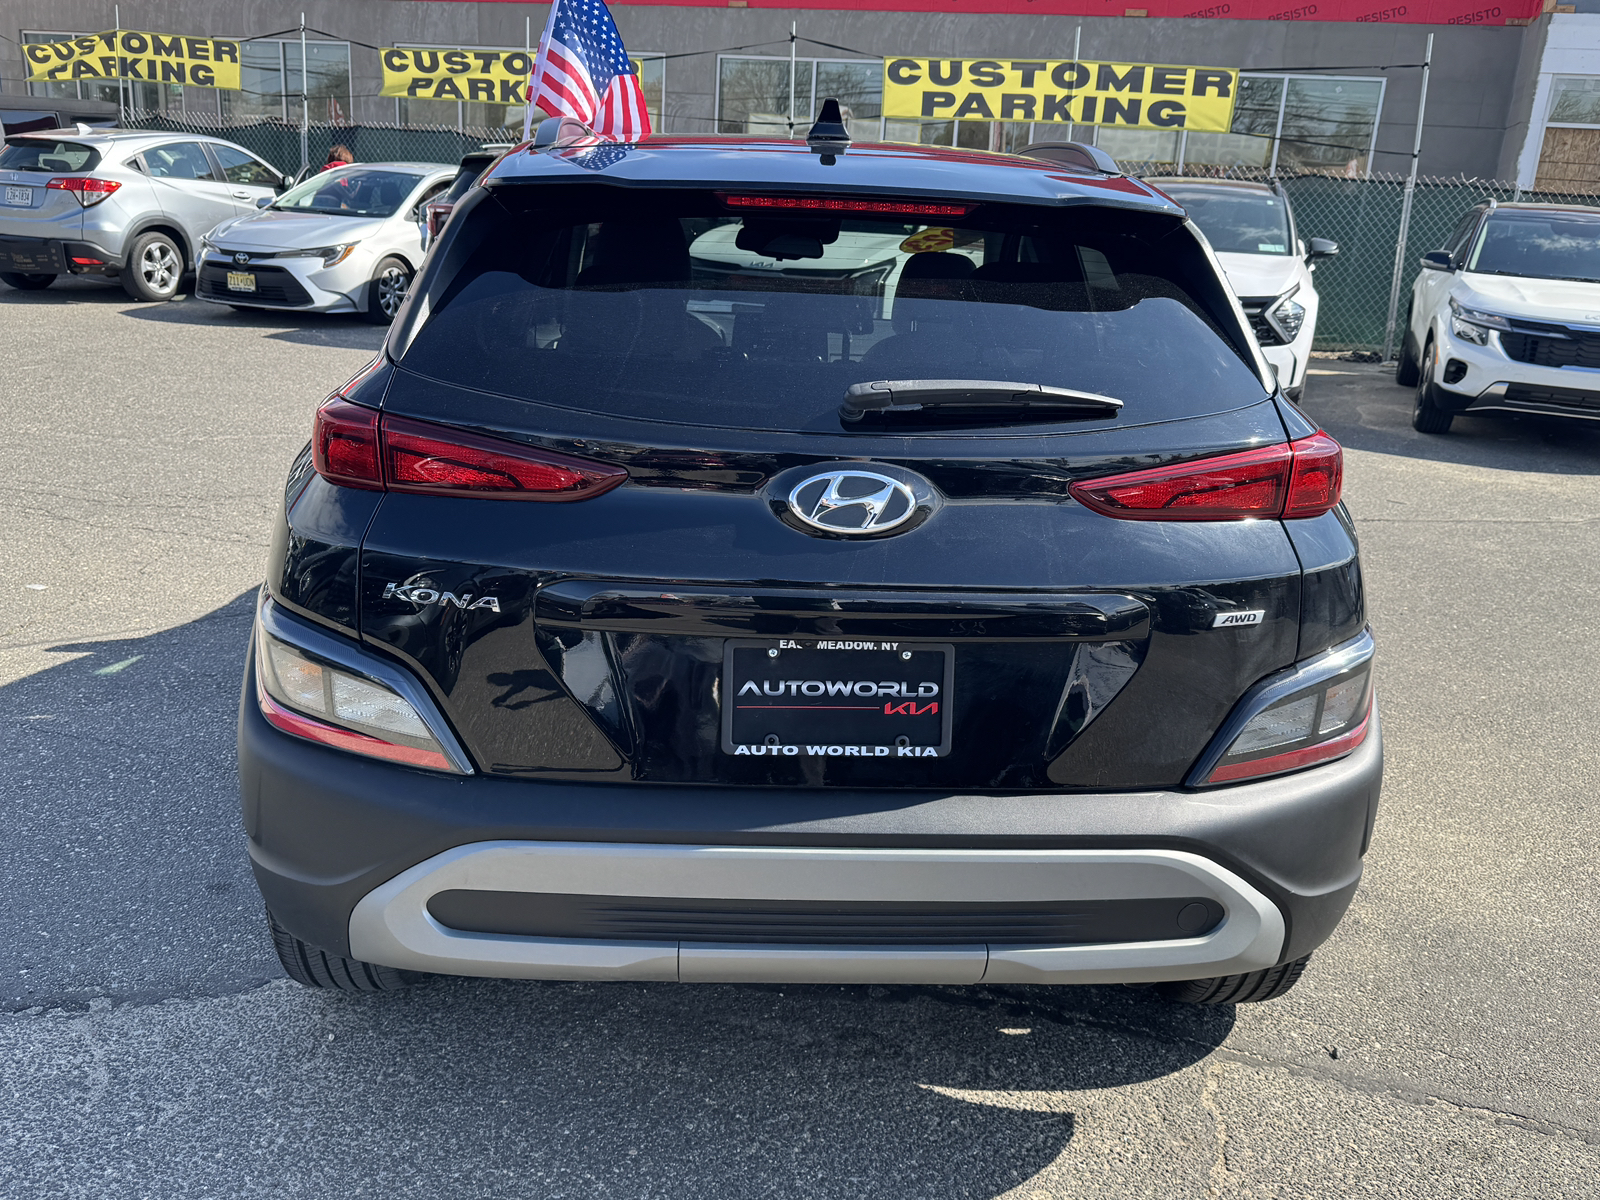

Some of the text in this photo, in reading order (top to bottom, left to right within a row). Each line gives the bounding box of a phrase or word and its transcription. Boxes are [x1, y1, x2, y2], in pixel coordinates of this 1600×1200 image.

[27, 31, 239, 64] CUSTOMER
[47, 56, 216, 87] PARKING
[384, 50, 533, 76] CUSTO
[407, 77, 525, 104] PARK
[887, 59, 1233, 98] CUSTOMER
[921, 91, 1187, 128] PARKING
[382, 582, 501, 613] KONA
[1221, 613, 1257, 625] AWD
[881, 642, 899, 651] NY
[737, 680, 939, 698] AUTOWORLD
[884, 701, 939, 716] KIA
[734, 744, 938, 757] AUTO WORLD KIA
